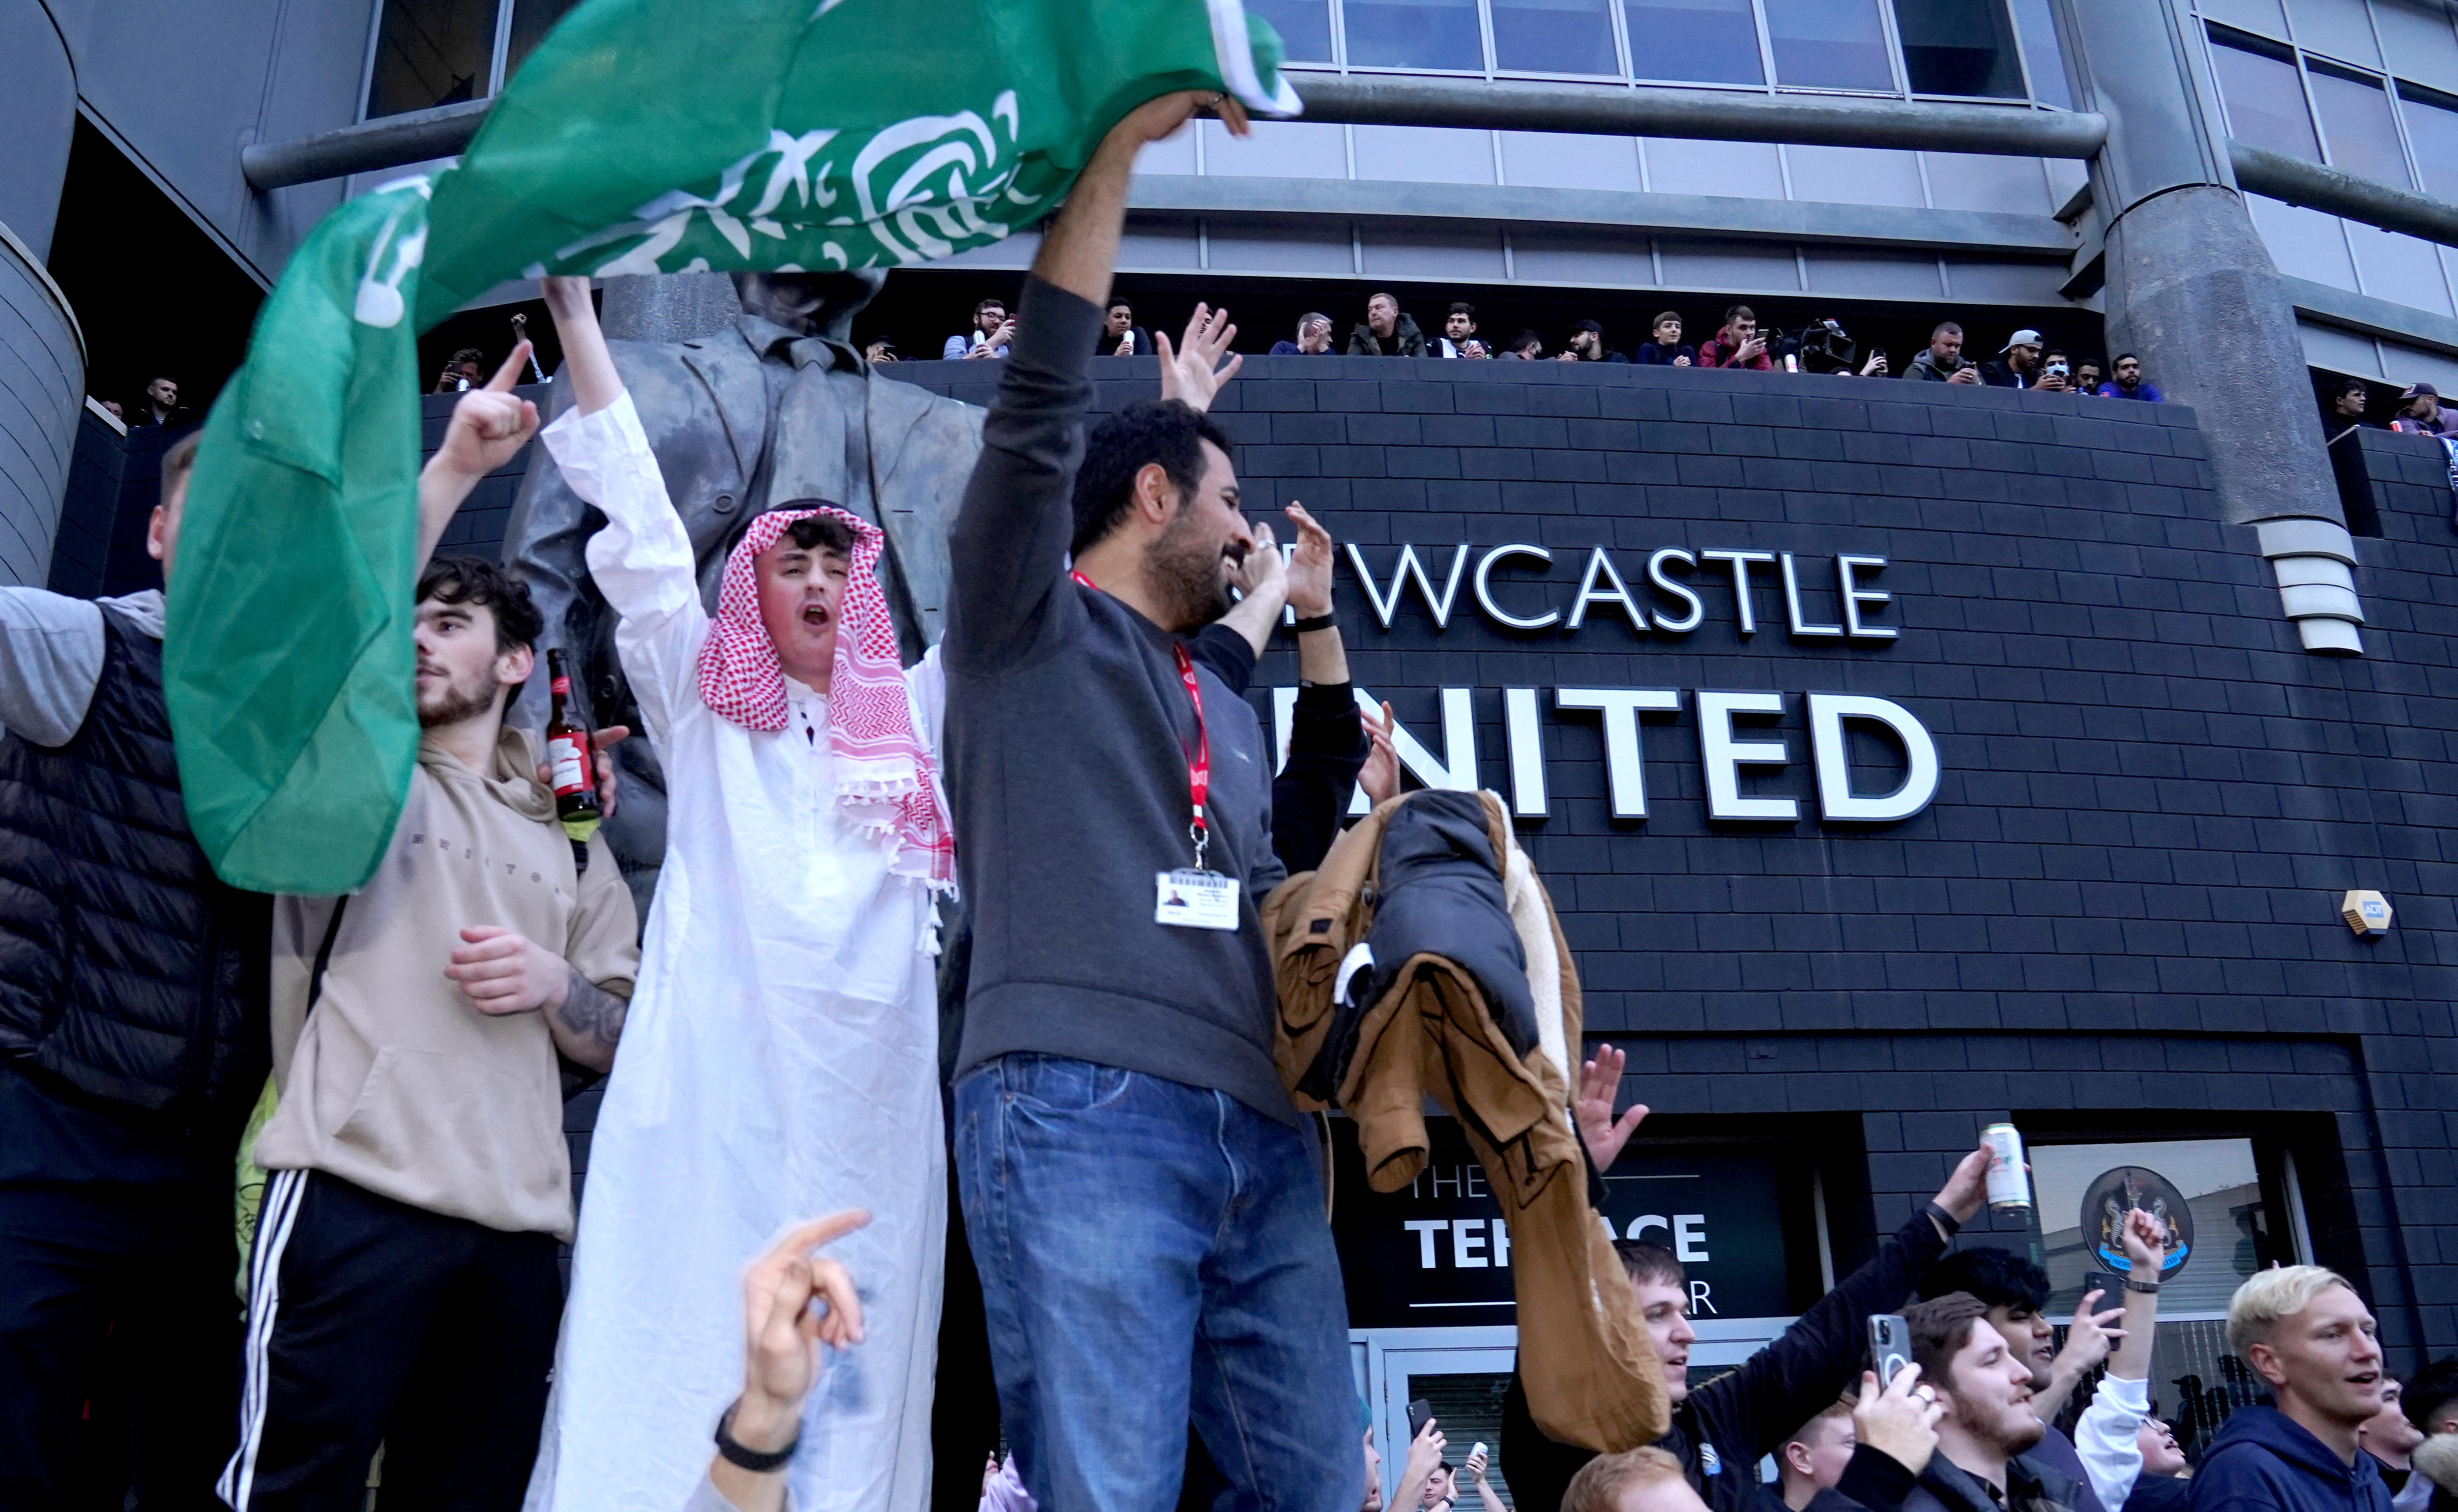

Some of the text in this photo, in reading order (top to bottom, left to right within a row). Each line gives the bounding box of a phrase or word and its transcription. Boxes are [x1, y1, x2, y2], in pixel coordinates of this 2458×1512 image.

[1231, 543, 1898, 638] WCASTLE
[2366, 903, 2383, 915] ADT
[1404, 1214, 1710, 1269] TECE
